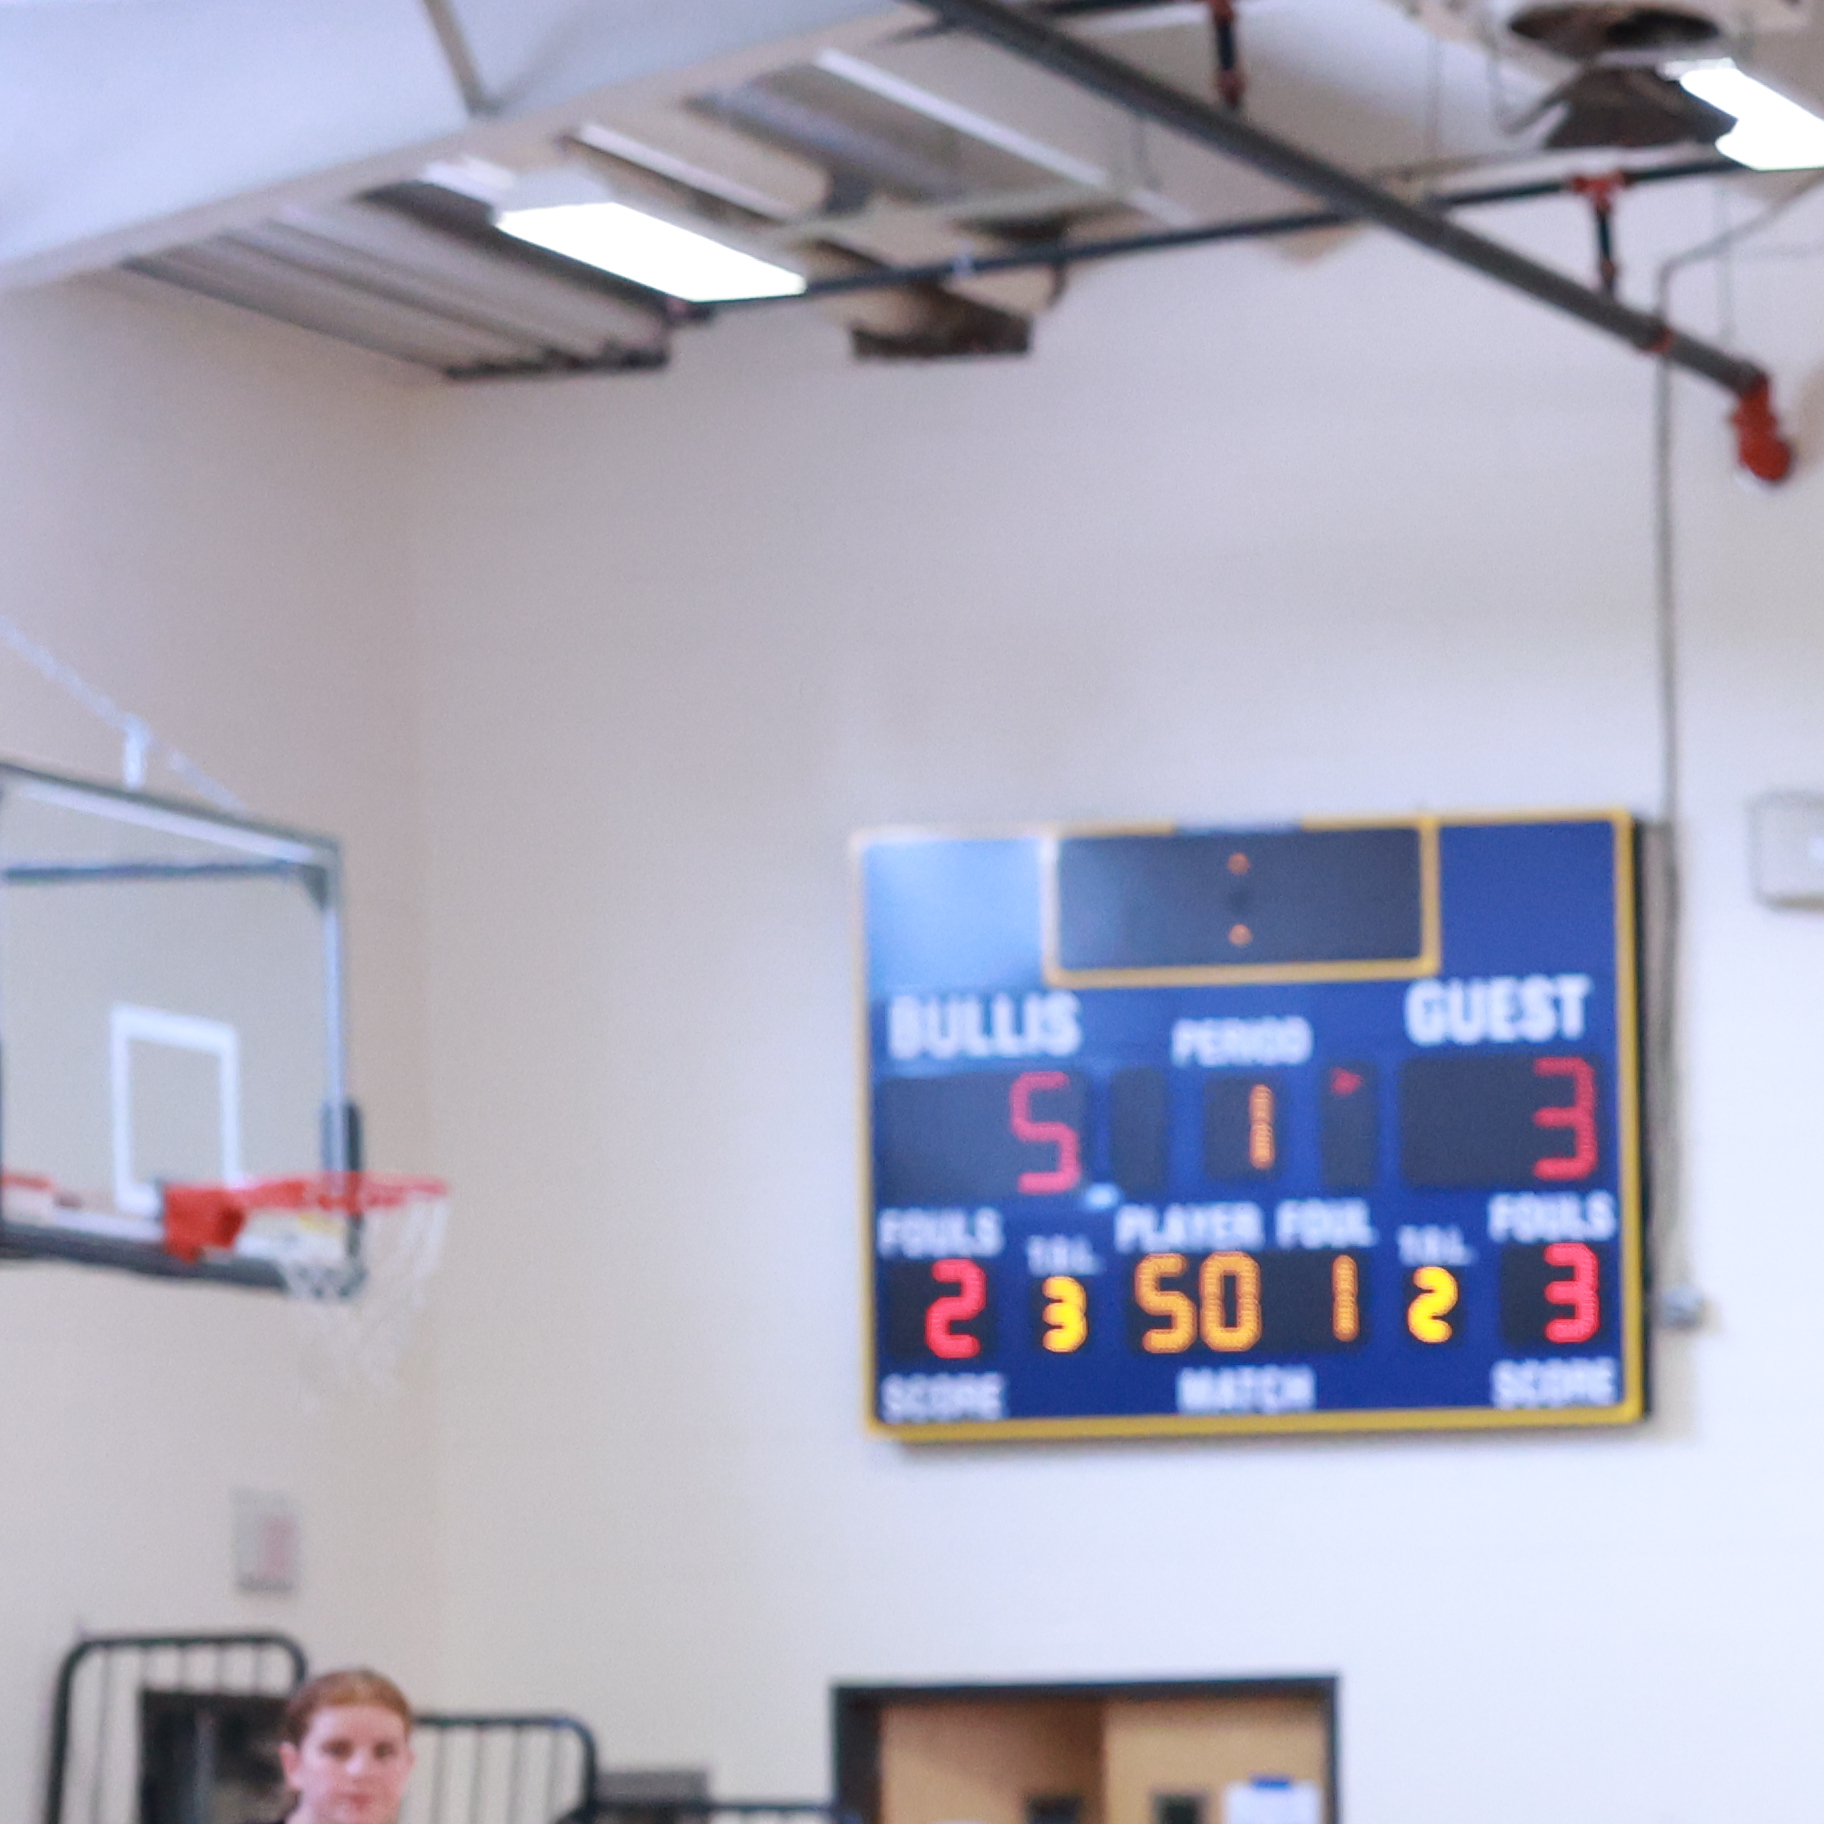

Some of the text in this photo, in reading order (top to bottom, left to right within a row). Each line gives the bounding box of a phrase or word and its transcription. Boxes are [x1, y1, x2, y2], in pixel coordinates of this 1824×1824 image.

[890, 993, 1079, 1057] BULLIS
[1173, 1019, 1311, 1064] PERIOD
[1407, 976, 1591, 1044] GUEST
[1010, 1072, 1080, 1193] 5
[1249, 1085, 1274, 1168] 1
[1534, 1057, 1595, 1179] 3
[879, 1210, 1001, 1256] FOULS
[1117, 1206, 1262, 1250] PLAYER
[1491, 1193, 1615, 1240] FOULS
[926, 1259, 985, 1357] 2
[1043, 1277, 1086, 1351] 3
[1135, 1252, 1261, 1352] 50
[1333, 1255, 1358, 1340] 1
[1408, 1266, 1457, 1341] 2
[1544, 1243, 1599, 1341] 3
